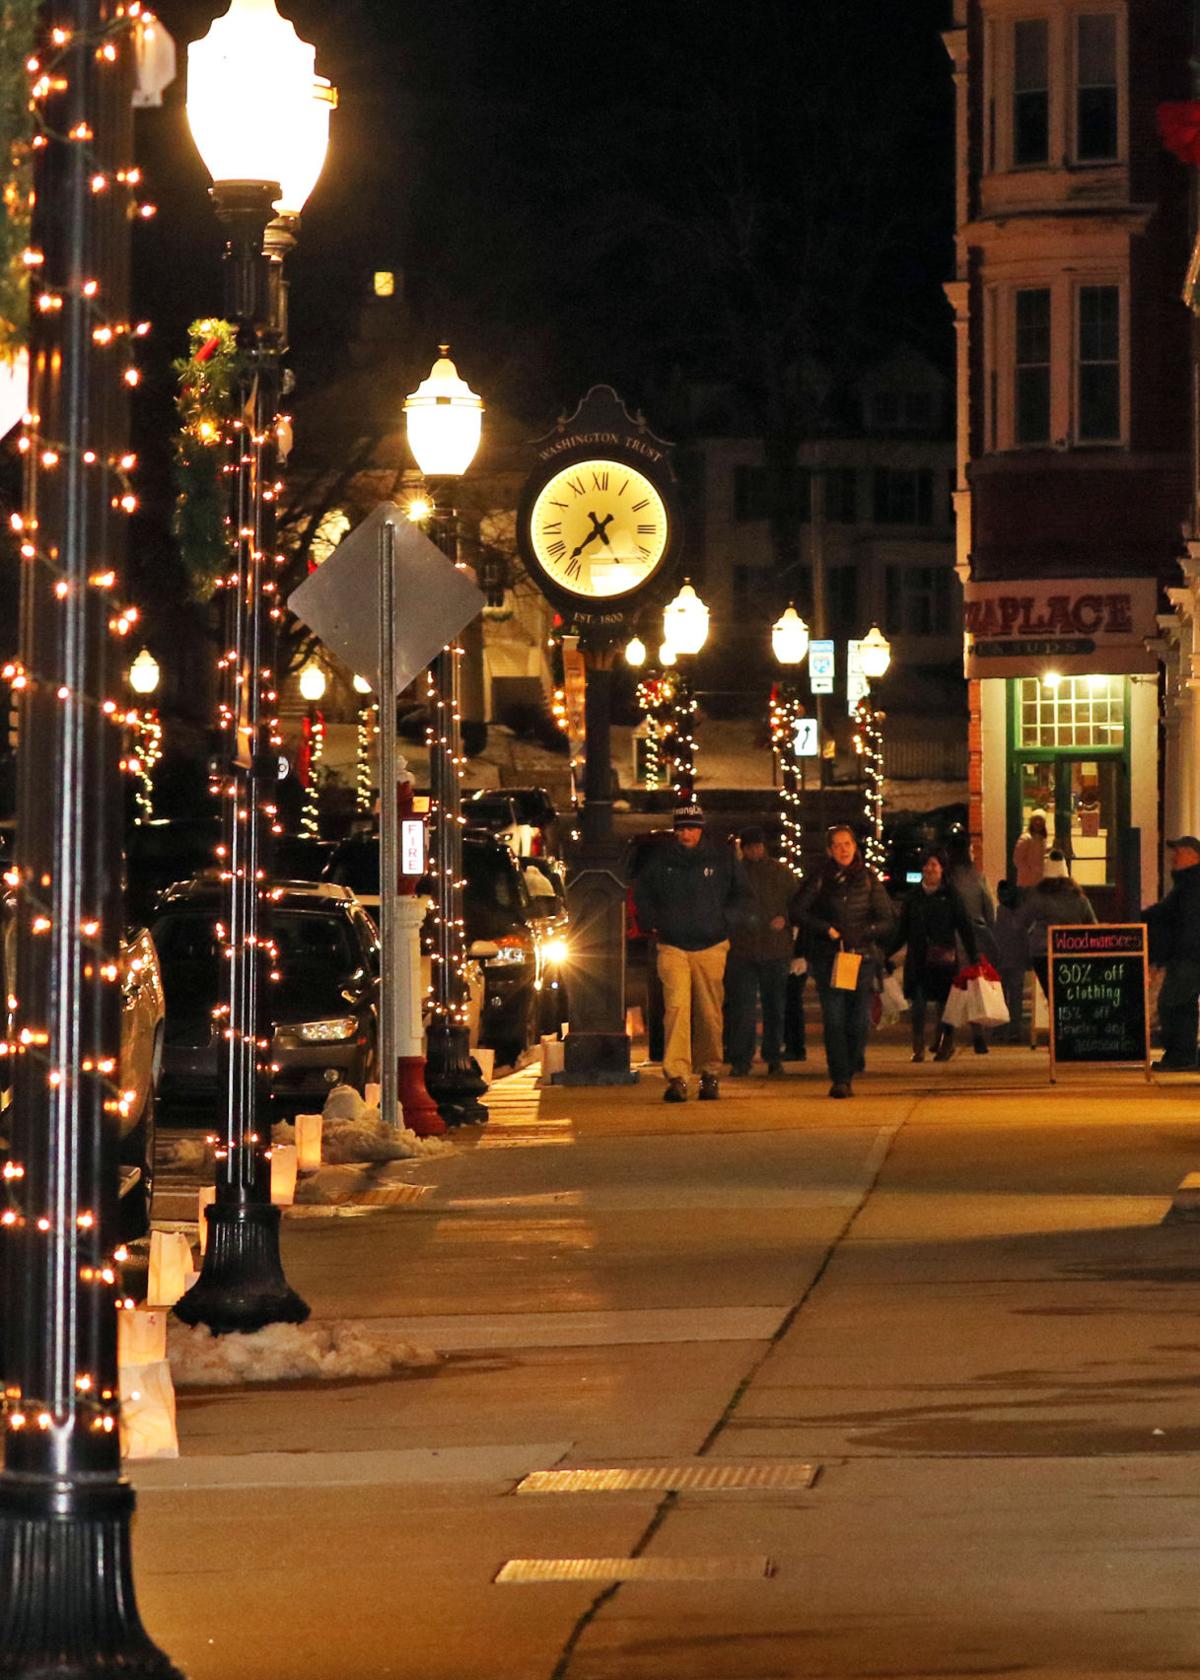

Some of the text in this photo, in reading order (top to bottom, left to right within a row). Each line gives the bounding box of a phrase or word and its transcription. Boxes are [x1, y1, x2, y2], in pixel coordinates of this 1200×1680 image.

[539, 432, 663, 462] WASHINGTON TRUST
[408, 824, 417, 871] FIRE
[1058, 963, 1125, 984] 30% off
[1067, 984, 1121, 1008] clothing
